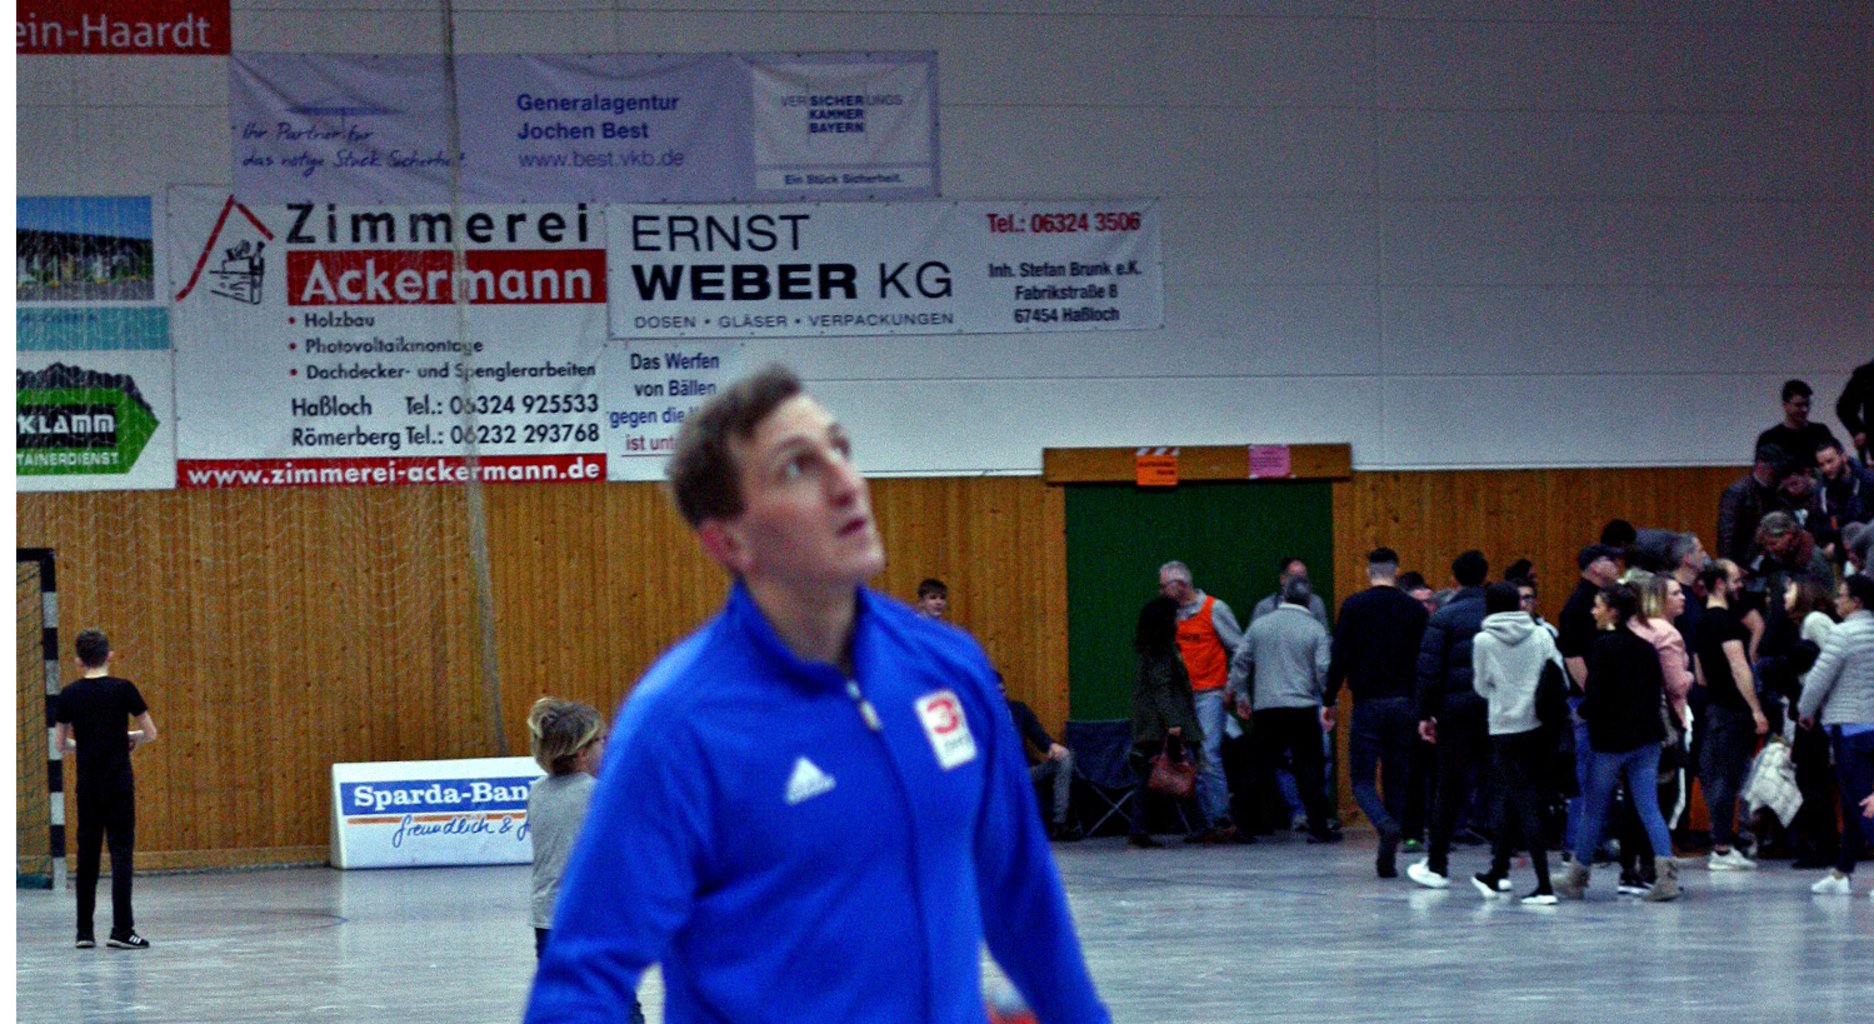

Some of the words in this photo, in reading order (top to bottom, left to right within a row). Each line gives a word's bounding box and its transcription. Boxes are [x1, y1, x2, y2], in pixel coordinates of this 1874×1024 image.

[517, 94, 679, 115] Generalagentur
[809, 108, 865, 120] KAMMER
[518, 122, 595, 140] Jochen
[602, 121, 649, 139] Best
[809, 122, 865, 133] BAYERN
[243, 151, 274, 167] das
[519, 150, 685, 167] www.best.vkb.de
[286, 202, 589, 244] Zimmerei
[632, 214, 810, 252] ERNST
[987, 213, 1026, 233] Tel.:
[1030, 213, 1089, 234] 06324
[1094, 211, 1142, 232] 3506
[1020, 262, 1065, 278] Stefan
[301, 262, 592, 302] Ackermann
[631, 263, 858, 302] WEBER
[879, 260, 953, 299] KG
[304, 311, 375, 328] Holzbau
[634, 315, 697, 329] DOSEN
[718, 314, 788, 328] GLÄSER
[808, 312, 954, 327] VERPACKUNGEN
[1014, 308, 1059, 323] 67454
[305, 336, 484, 357] Photovoltaikmontage
[306, 362, 410, 380] Dachdecker-
[417, 362, 450, 378] und
[454, 361, 596, 382] Spenglerarbeiten
[631, 353, 661, 370] Das
[664, 352, 720, 369] Werfen
[634, 383, 664, 397] von
[668, 380, 717, 397] Bällen
[292, 394, 373, 416] Haßloch
[405, 394, 443, 415] Tel.:
[450, 395, 516, 415] 06324
[522, 394, 599, 415] 925533
[609, 411, 657, 428] gegen
[662, 407, 686, 423] die
[292, 424, 401, 450] Römerberg
[405, 424, 444, 444] Tel.:
[450, 425, 517, 444] 06232
[524, 423, 600, 443] 293768
[626, 434, 646, 451] ist
[188, 456, 601, 485] www.zimmerei-ackermann.de
[392, 814, 495, 848] freundlich
